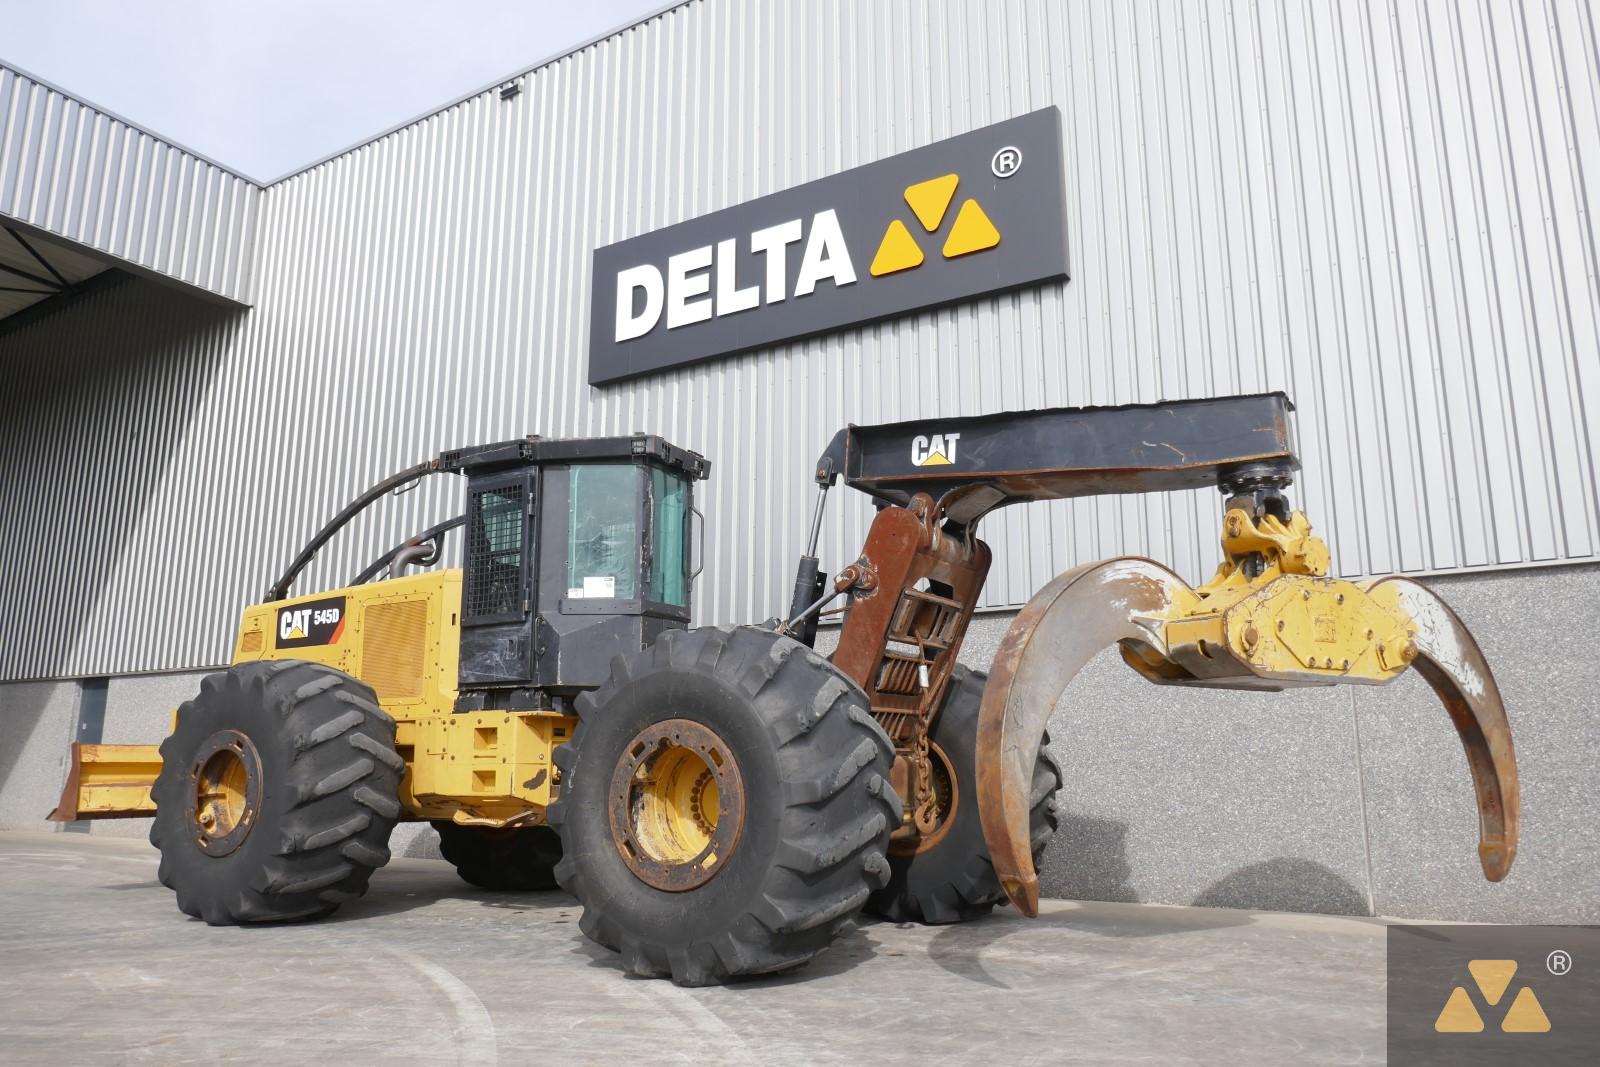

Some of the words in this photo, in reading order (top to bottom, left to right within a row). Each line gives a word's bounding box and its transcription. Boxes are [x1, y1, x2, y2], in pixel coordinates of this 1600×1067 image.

[615, 208, 857, 343] DELTA
[911, 432, 961, 467] CAT
[280, 609, 312, 640] CAT
[313, 608, 340, 626] 545D
